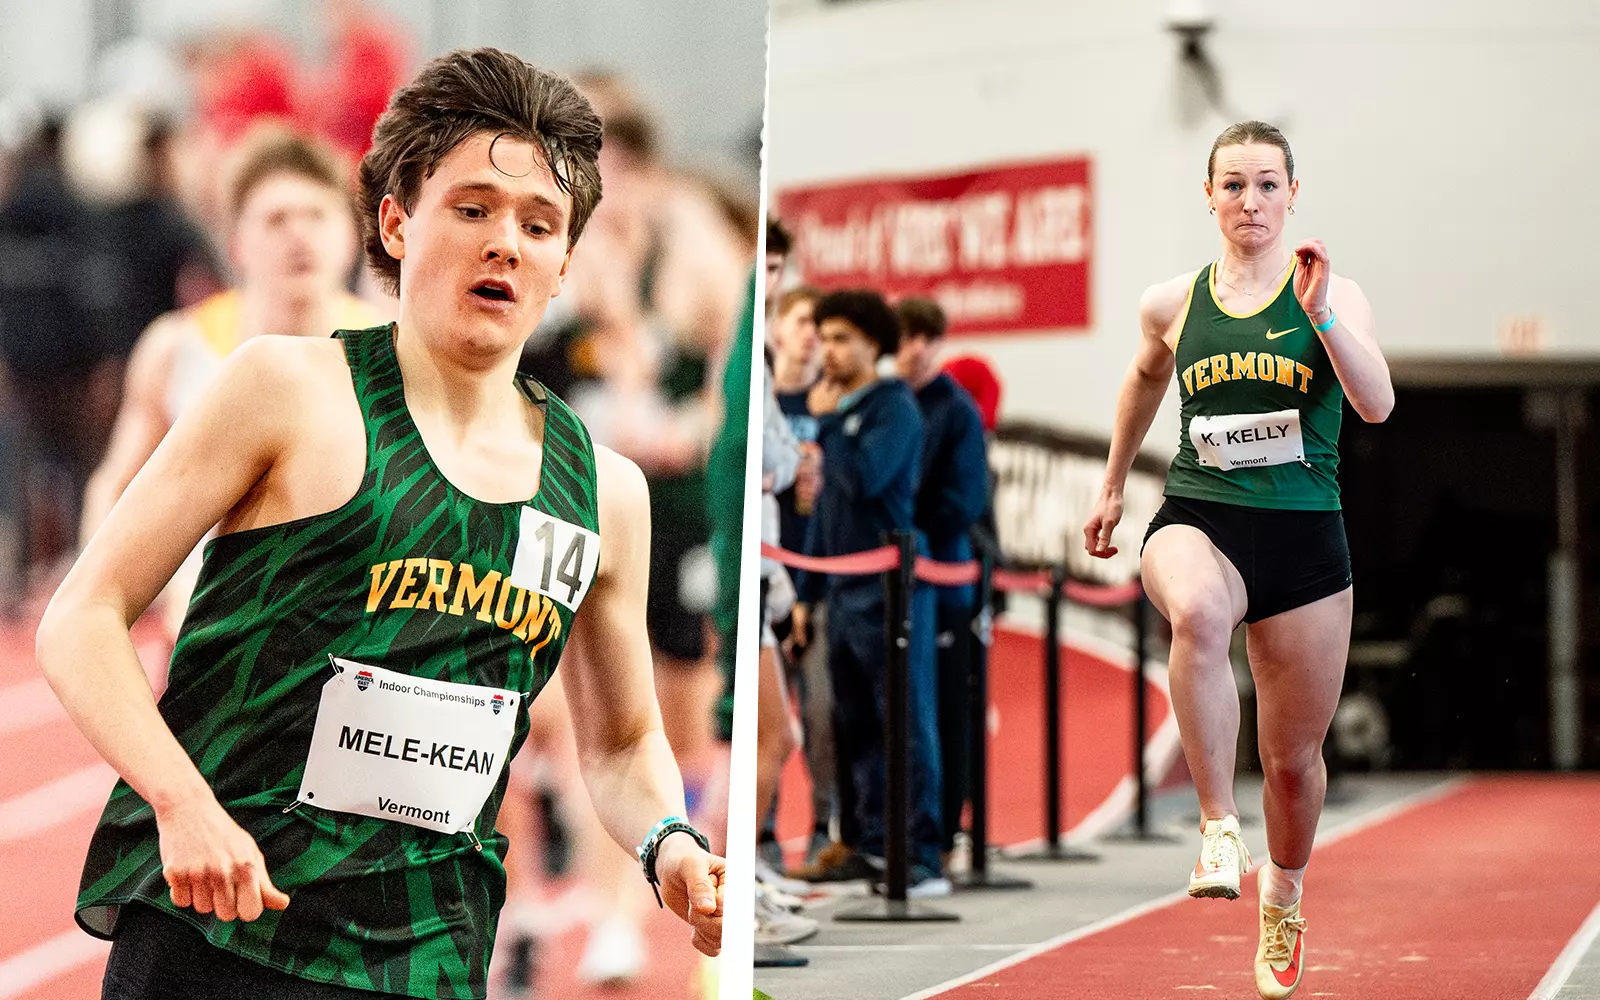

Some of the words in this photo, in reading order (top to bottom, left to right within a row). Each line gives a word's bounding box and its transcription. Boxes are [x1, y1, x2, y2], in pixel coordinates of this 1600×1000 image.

[1182, 352, 1313, 396] VERMONT
[1201, 432, 1220, 447] K.
[1226, 424, 1290, 445] KELLY
[1229, 456, 1268, 467] Vermont
[534, 520, 586, 604] 14
[366, 557, 562, 661] VERMONT
[379, 680, 411, 694] Indoor
[413, 685, 486, 708] Championships
[338, 725, 495, 776] MELE-KEAN
[377, 796, 451, 825] Vermont
